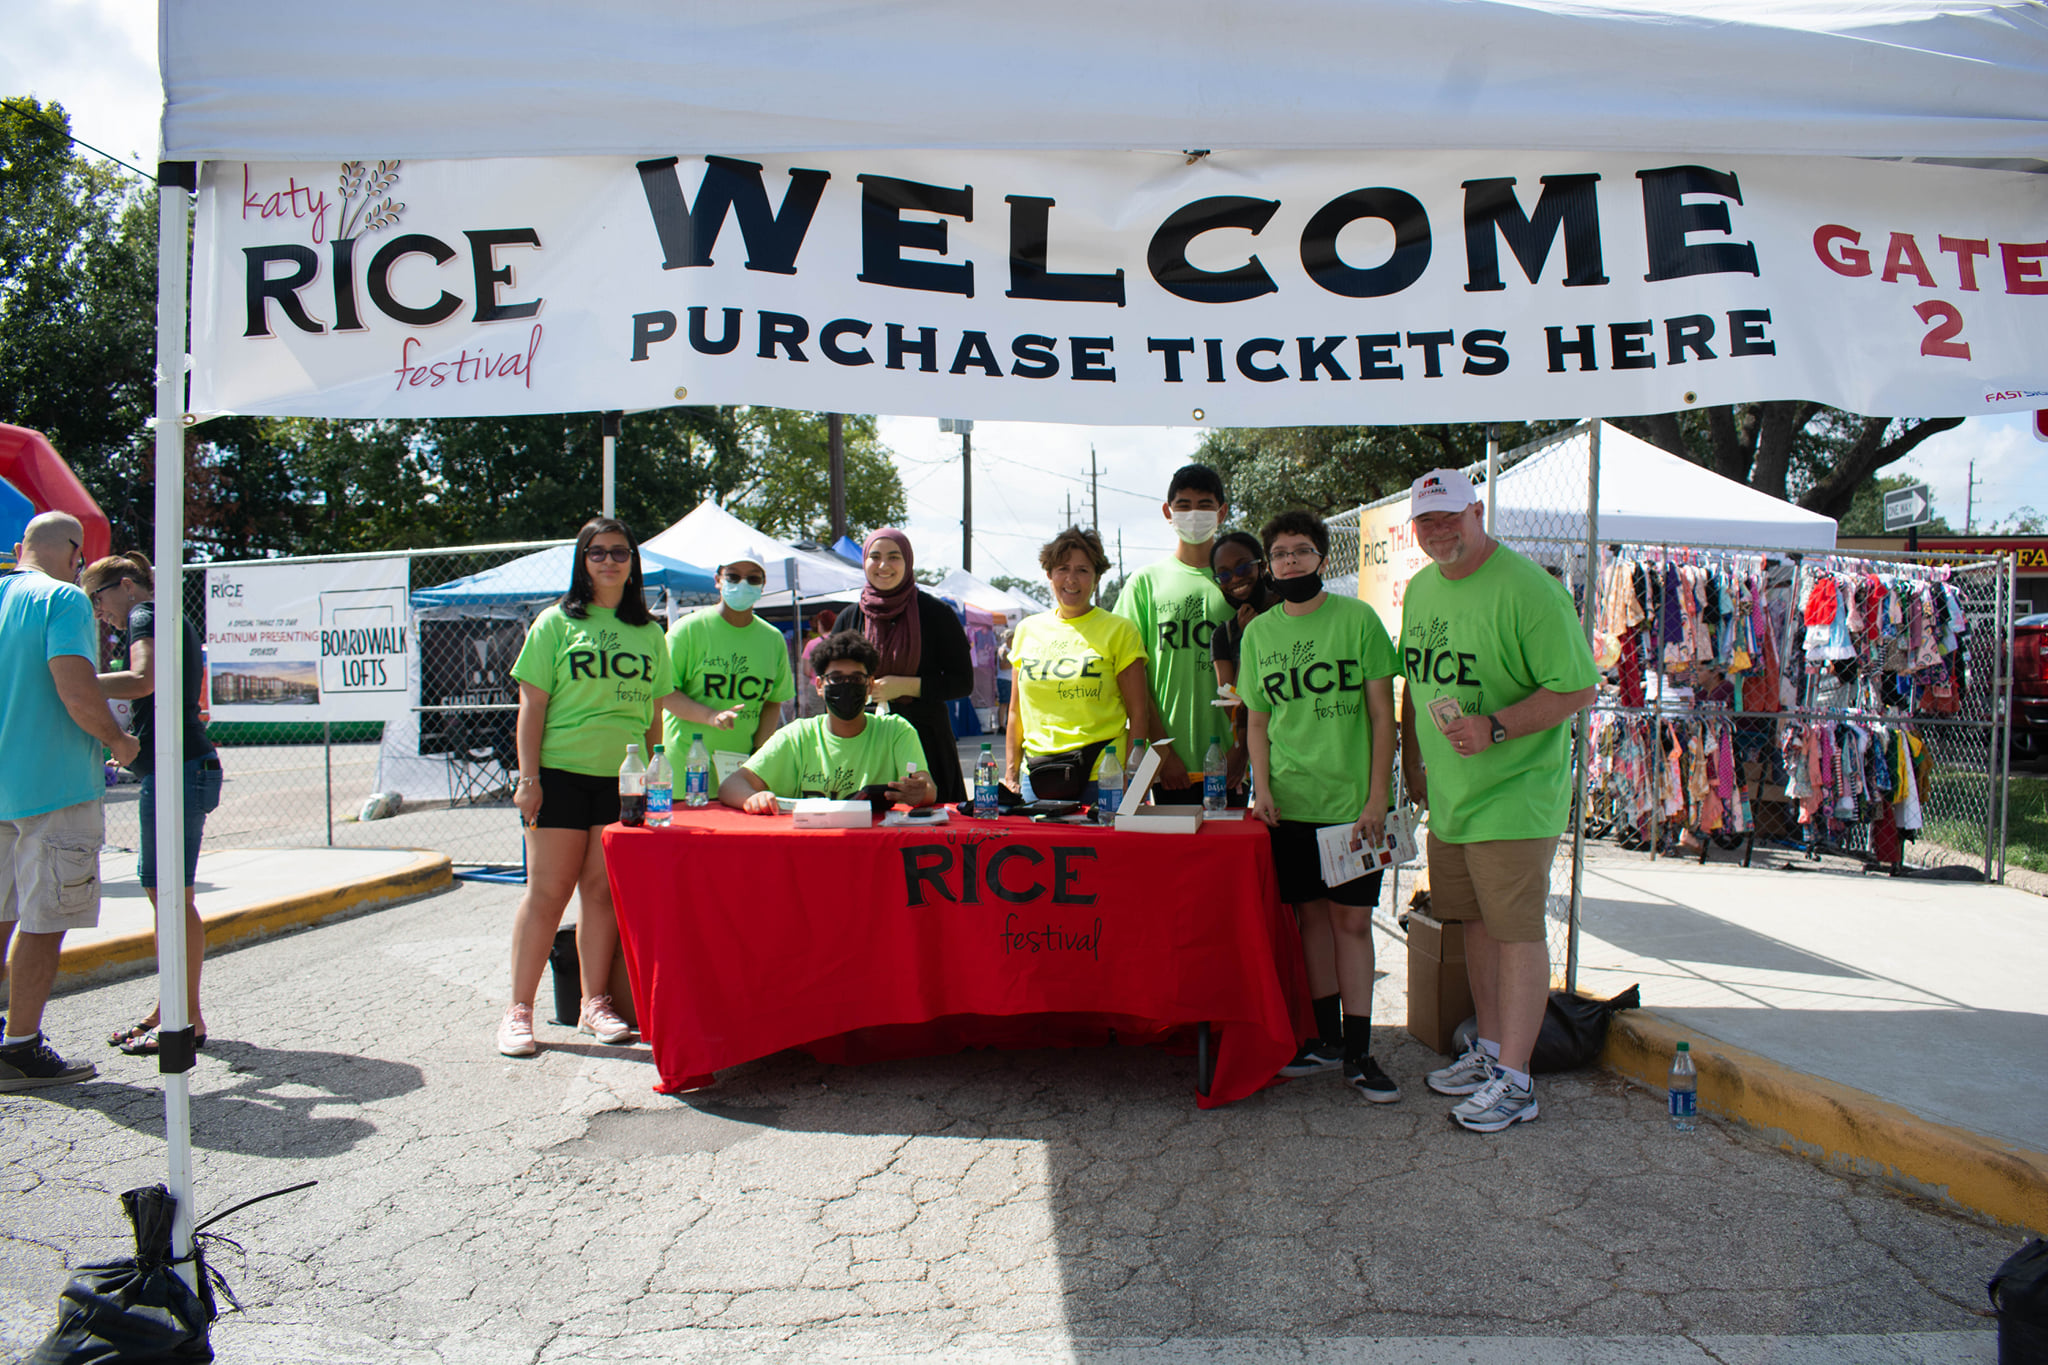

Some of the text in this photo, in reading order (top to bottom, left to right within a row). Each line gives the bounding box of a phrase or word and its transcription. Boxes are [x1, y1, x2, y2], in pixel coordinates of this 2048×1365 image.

[243, 163, 332, 244] katy
[636, 155, 1760, 307] WELCOME
[1813, 224, 2048, 296] GATE
[241, 228, 546, 339] RICE
[631, 307, 1776, 382] PURCHASE TICKETS HERE
[1913, 300, 1971, 361] 2
[395, 324, 543, 390] festival
[1888, 503, 1912, 517] ONE WAY
[1364, 540, 1388, 567] RICE
[211, 584, 243, 598] RICE
[209, 630, 320, 644] PLATINUM PRESENTING
[321, 627, 408, 657] BOARDWALK
[1158, 620, 1217, 651] RIC
[342, 659, 387, 687] LOFTS
[569, 650, 653, 682] RICE
[703, 650, 729, 674] katy
[1018, 655, 1104, 681] RICE
[1259, 649, 1290, 671] katy
[1405, 647, 1481, 686] RICE
[1057, 681, 1103, 701] festival
[1263, 659, 1362, 706] RICE
[1313, 698, 1360, 721] festiva
[802, 758, 831, 793] katy
[899, 844, 1100, 907] RICE
[1000, 913, 1102, 960] festival
